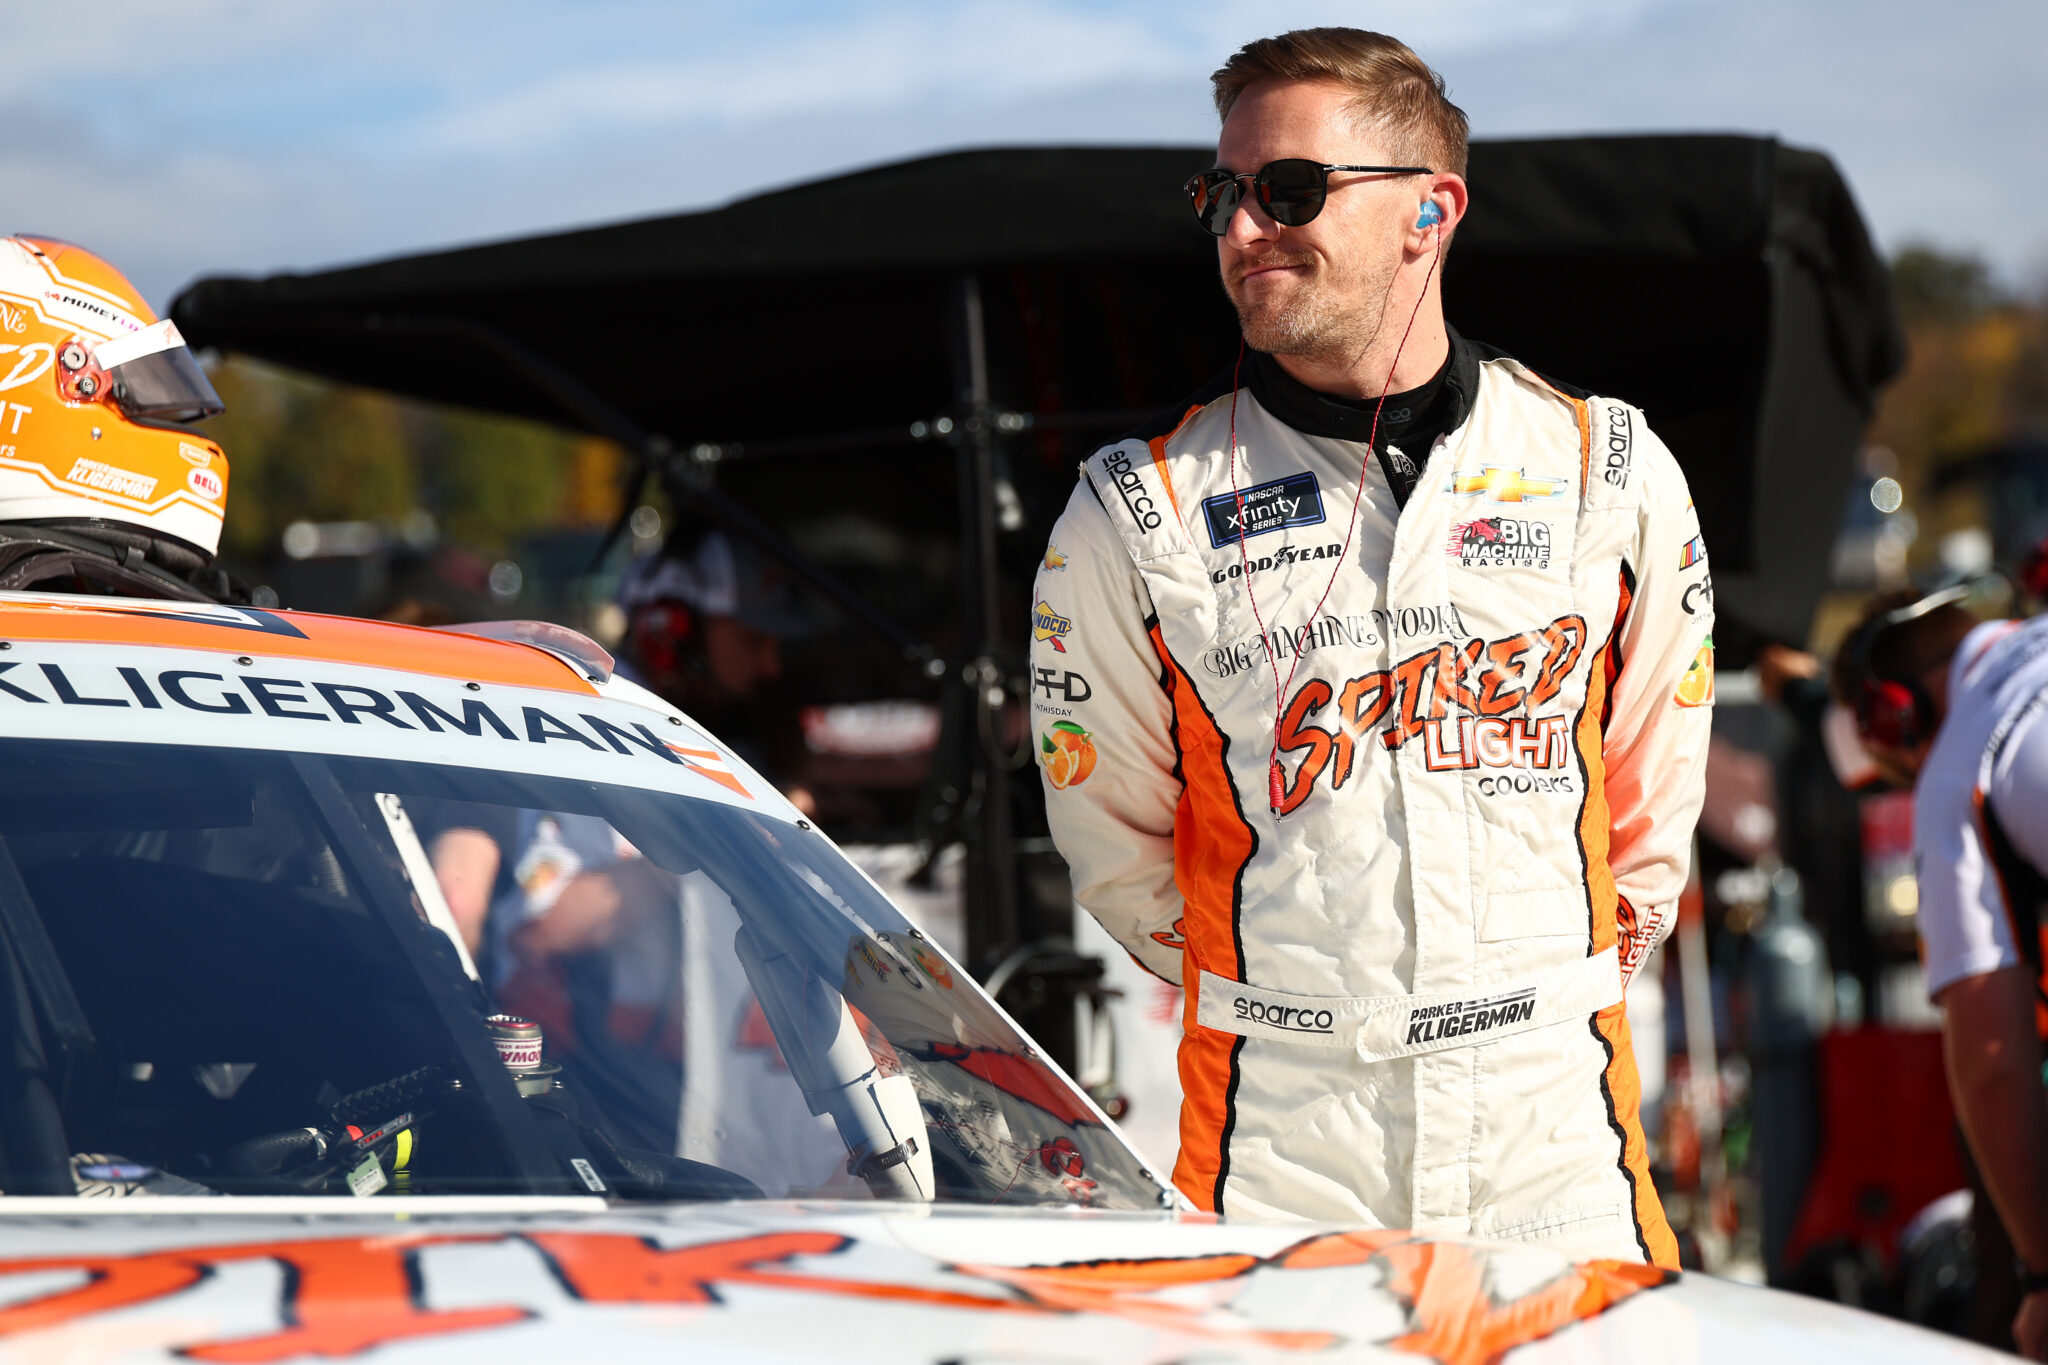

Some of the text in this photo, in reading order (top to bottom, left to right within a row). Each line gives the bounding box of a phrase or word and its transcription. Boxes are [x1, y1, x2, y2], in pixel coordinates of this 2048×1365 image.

[1605, 406, 1632, 490] sparco
[66, 465, 155, 501] KLIGERMAN
[194, 474, 218, 494] BELL
[1102, 450, 1161, 534] sparco
[1248, 485, 1284, 503] NASCAR
[1226, 496, 1300, 530] xfinity
[1252, 516, 1282, 531] SERIES
[1500, 519, 1551, 547] BIG
[1461, 543, 1551, 560] MACHINE
[1462, 558, 1548, 569] RACING
[1204, 602, 1472, 678] BIG MACHINE VODKA
[0, 661, 683, 765] KLIGERMAN
[1270, 614, 1587, 817] SPIKED
[1424, 714, 1569, 772] LIGHT
[1478, 771, 1573, 797] coolers
[1234, 998, 1333, 1034] sparco
[1406, 1000, 1535, 1045] KLIGERMAN
[1410, 1002, 1463, 1021] PARKER
